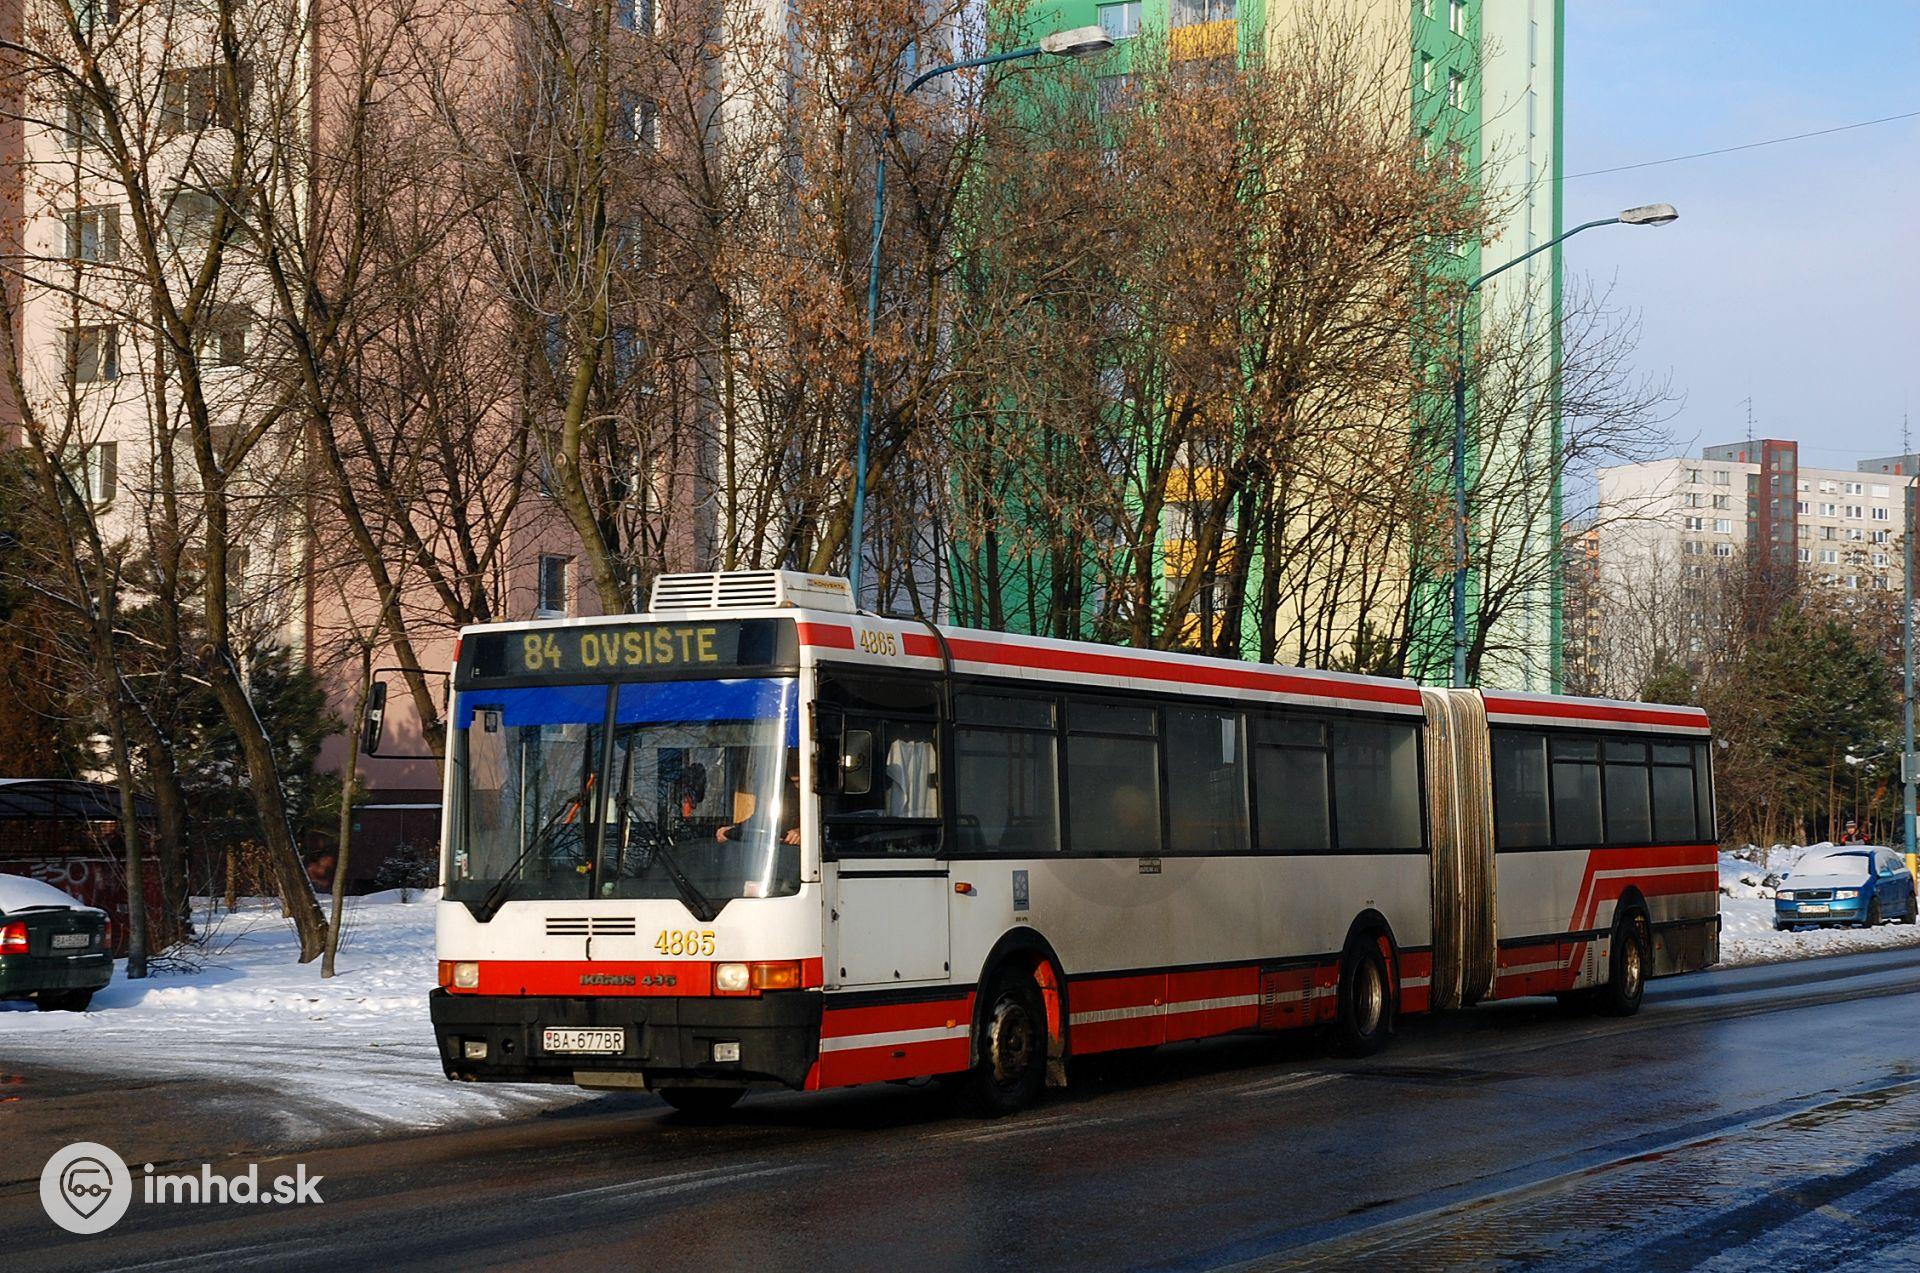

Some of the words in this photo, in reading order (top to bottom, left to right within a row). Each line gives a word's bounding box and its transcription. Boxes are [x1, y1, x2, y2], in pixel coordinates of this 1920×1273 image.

[523, 633, 562, 670] 84
[580, 627, 718, 667] OVSIŠTE
[860, 629, 896, 657] 4865
[654, 929, 715, 956] 4865
[553, 1032, 622, 1049] BA-677BR
